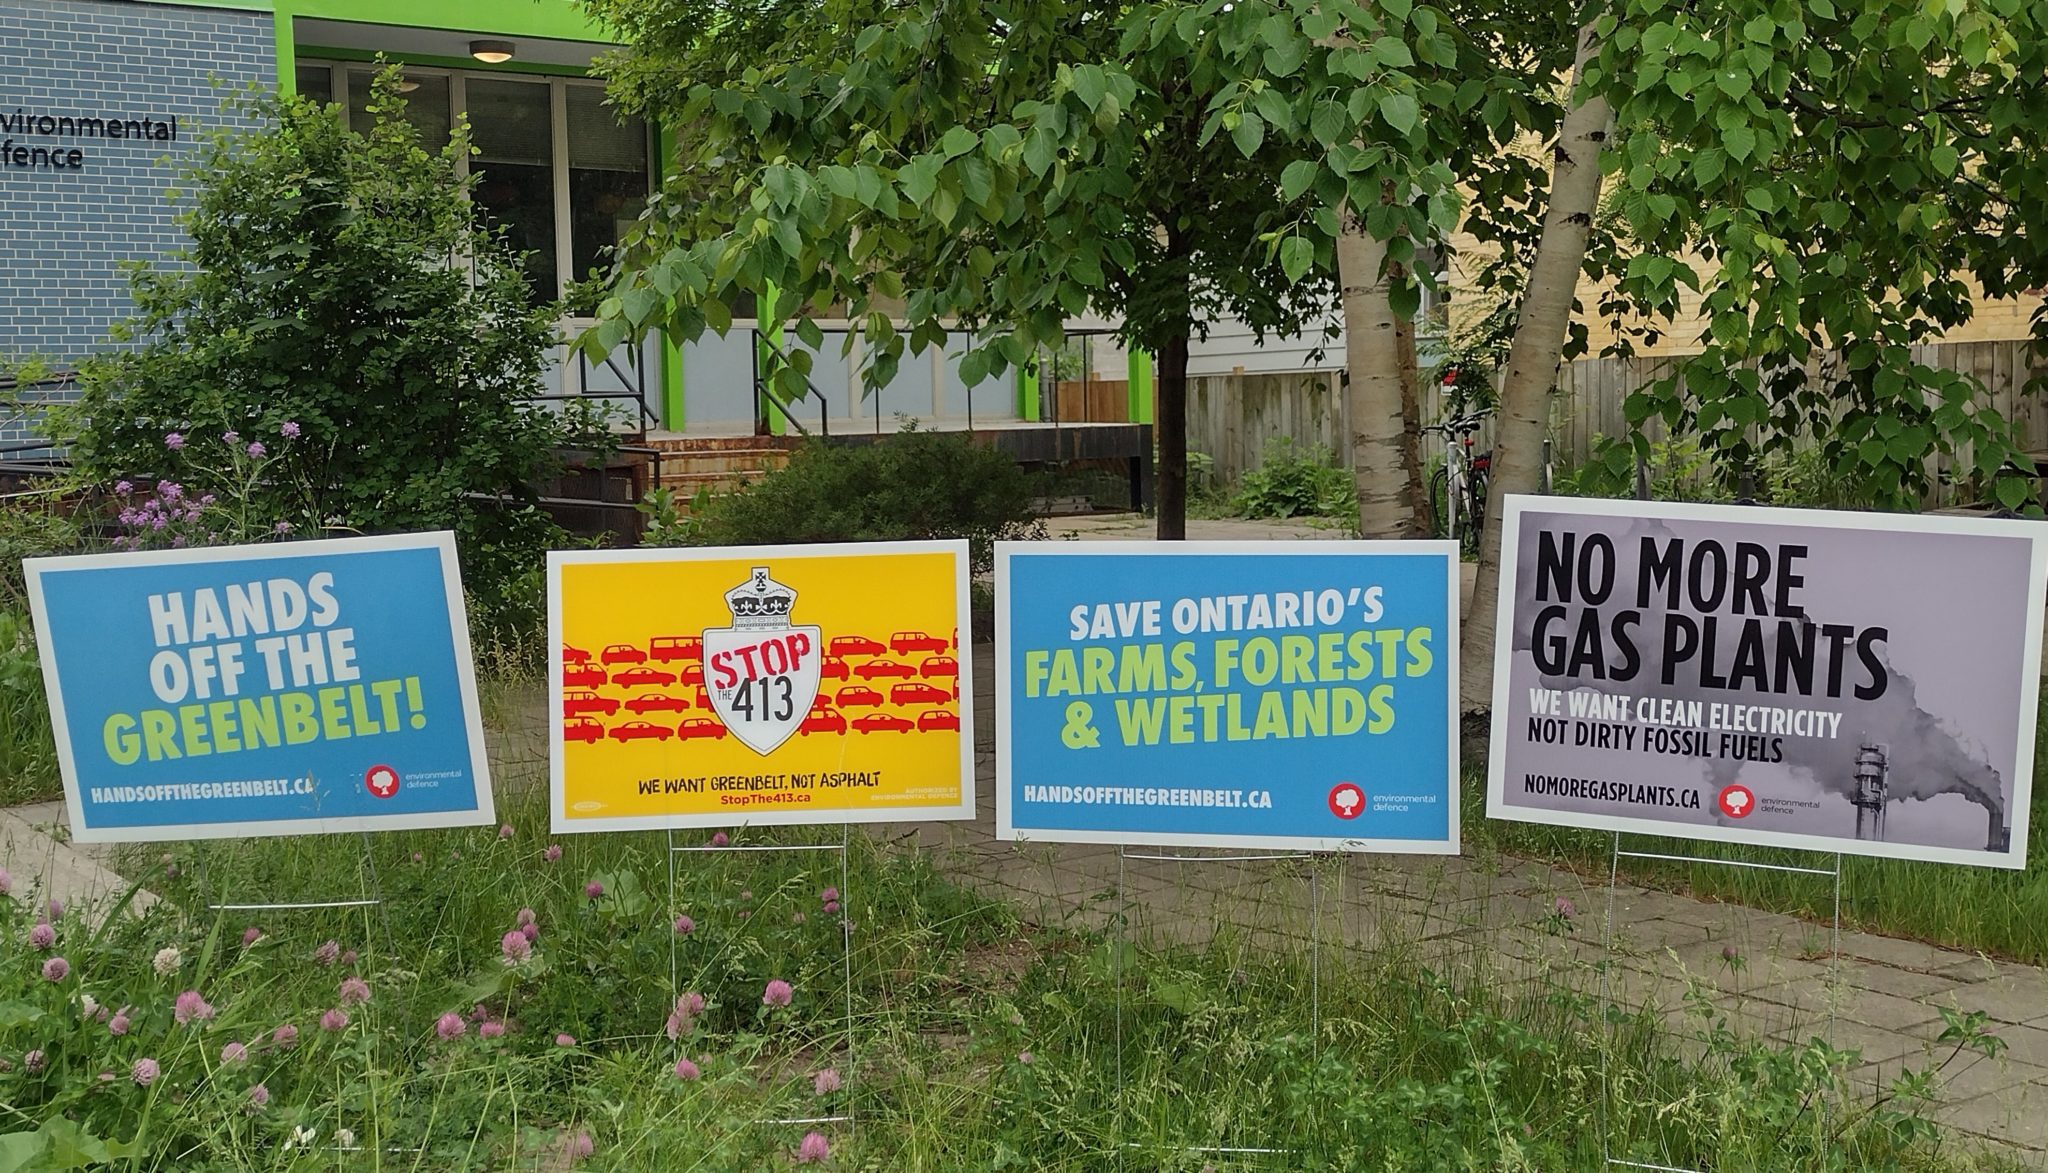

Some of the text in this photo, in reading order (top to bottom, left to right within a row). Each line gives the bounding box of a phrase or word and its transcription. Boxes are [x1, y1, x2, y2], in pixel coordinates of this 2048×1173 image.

[1, 139, 83, 168] fence
[1535, 530, 1809, 619] NO MORE
[148, 571, 339, 647] HANDS
[1070, 586, 1383, 641] SAVE ONTARIO'S
[149, 627, 361, 703] OFF THE
[711, 633, 810, 689] STOP
[1026, 627, 1433, 698] FARMS, FORESTS
[1531, 605, 1889, 701] GAS PLANTS
[103, 676, 427, 766] GREENBELT!
[717, 676, 793, 721] THE 413
[1061, 684, 1395, 749] & WETLANDS
[1529, 688, 1843, 739] WE WANT CLEAN ELECTRICITY
[1528, 717, 1783, 763] NOT DIRTY FOSSIL FUELS
[405, 770, 462, 781] environmental
[407, 780, 439, 789] defence
[639, 771, 881, 795] WE WANT GREENBELT, NOT ASPHALT
[1024, 784, 1272, 809] HANDSOFFTHEGREENBELT.CA
[1524, 774, 1700, 809] NOMOREGASPLANTS.CA
[720, 793, 811, 806] StopThe413.ca
[1373, 794, 1436, 803] environmental
[1373, 803, 1409, 812] defence
[1761, 798, 1820, 809] environmental
[1761, 805, 1794, 815] defence
